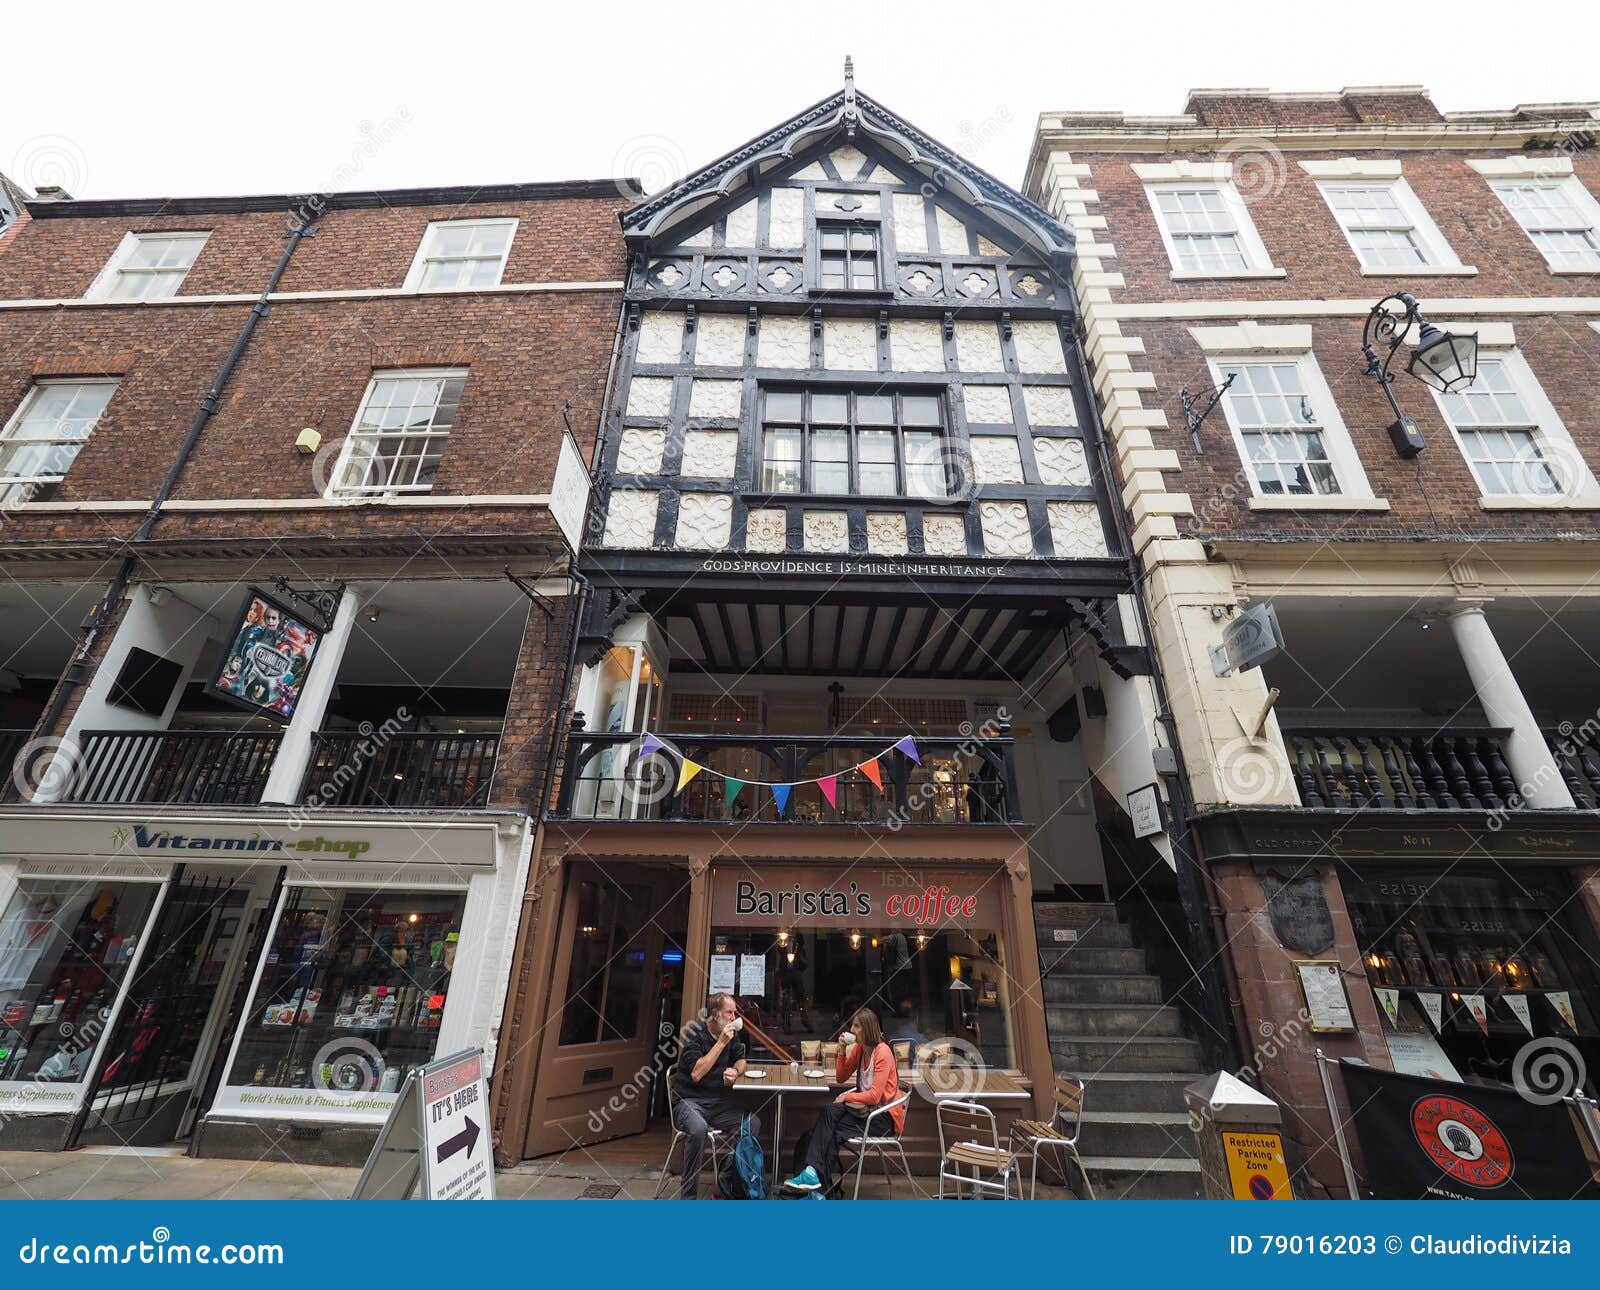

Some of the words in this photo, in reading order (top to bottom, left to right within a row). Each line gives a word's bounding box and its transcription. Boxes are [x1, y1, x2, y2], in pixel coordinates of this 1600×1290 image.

[744, 559, 833, 573] PROVIDENCE
[858, 562, 897, 574] MINE
[902, 563, 1006, 576] INHERITANCE
[132, 824, 371, 859] Vitamin-shop
[735, 879, 873, 917] Barista's
[886, 885, 978, 926] coffee
[239, 1092, 273, 1105] World's
[275, 1093, 304, 1105] Health
[313, 1095, 345, 1108] Fitness
[432, 1096, 453, 1123] IT'S
[454, 1083, 479, 1112] HERE
[1229, 1137, 1276, 1149] Restricted
[1237, 1148, 1273, 1161] Parking
[1245, 1160, 1269, 1170] Zone
